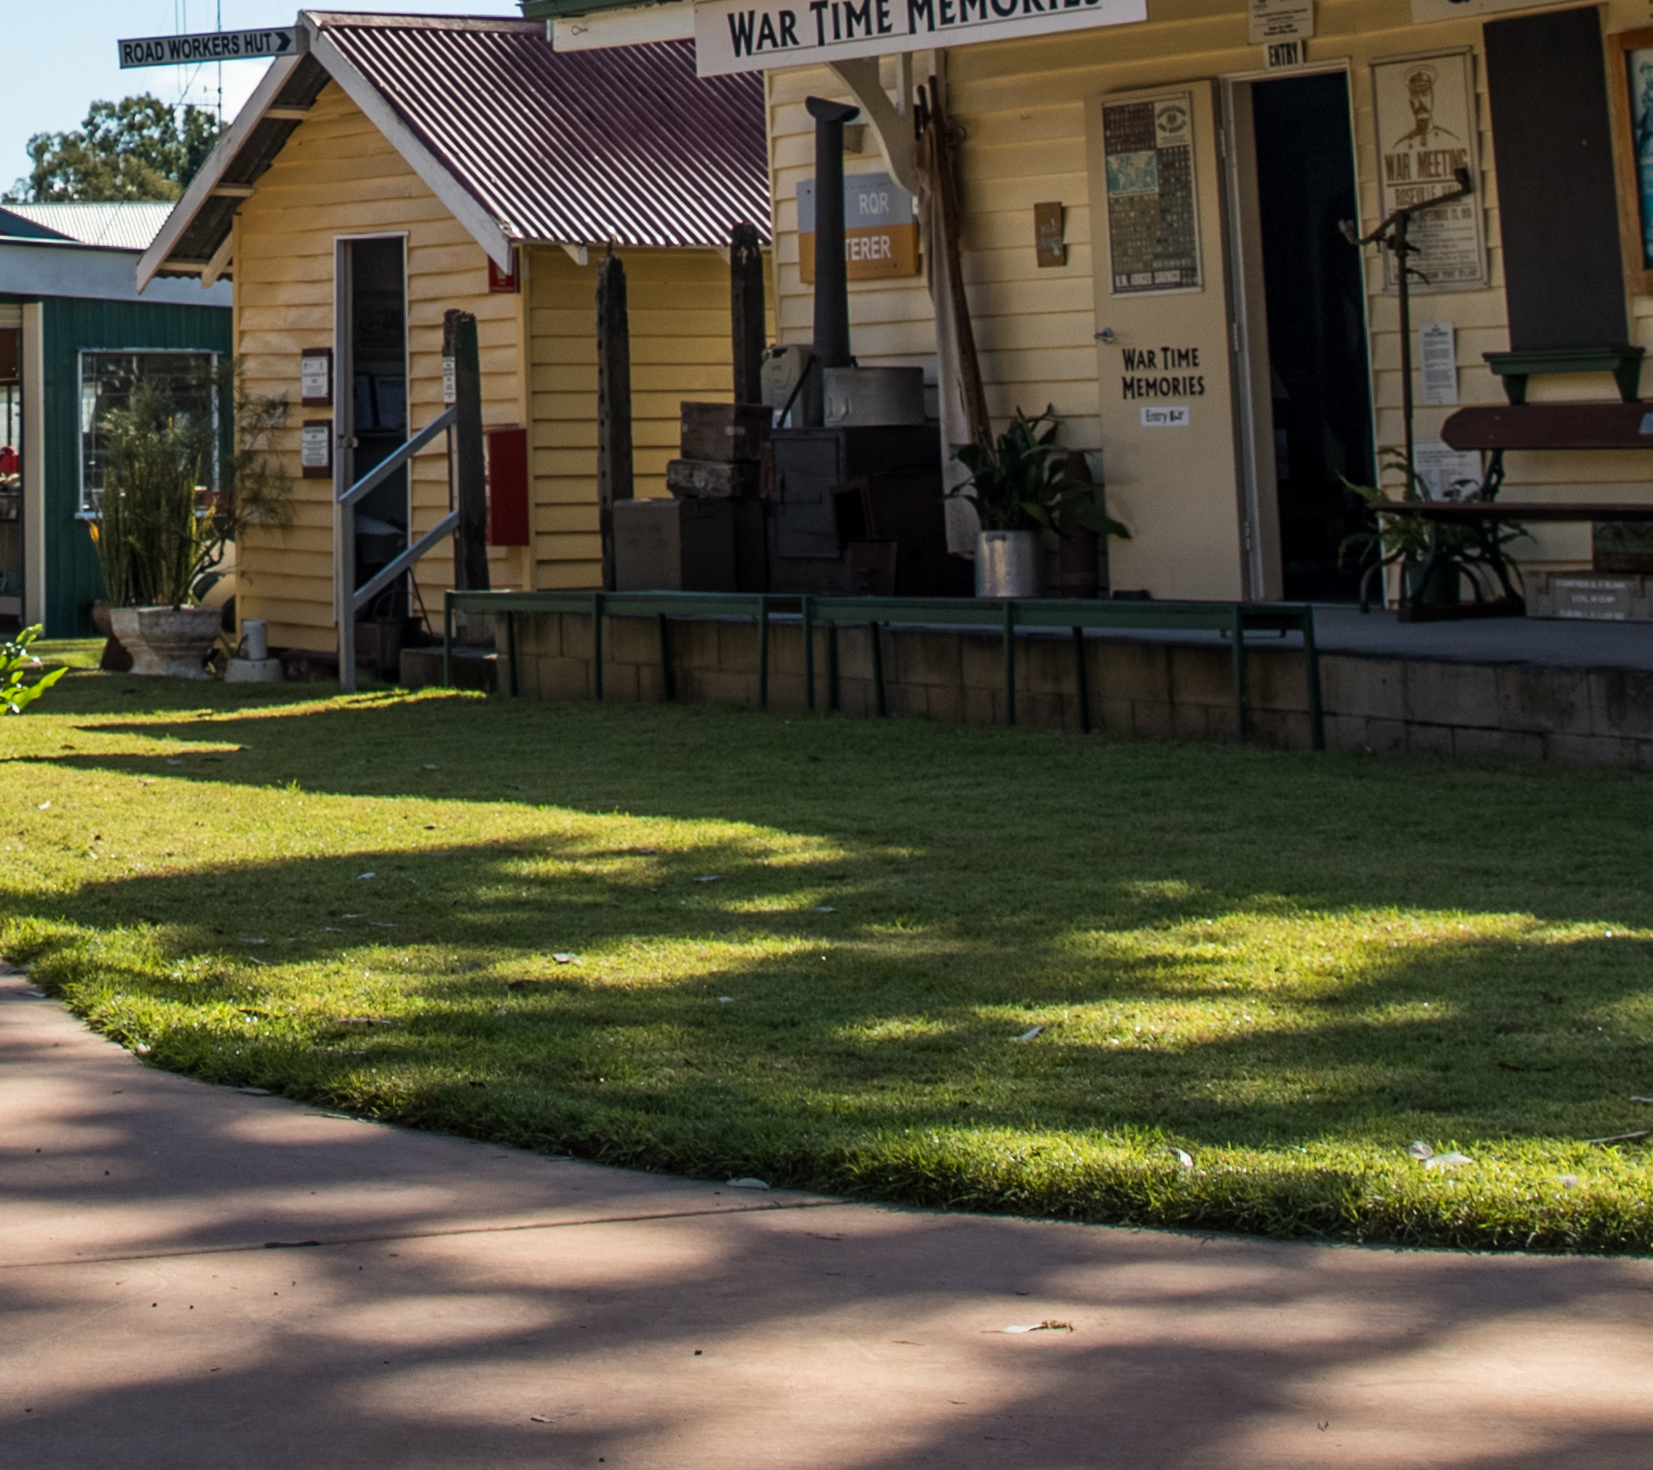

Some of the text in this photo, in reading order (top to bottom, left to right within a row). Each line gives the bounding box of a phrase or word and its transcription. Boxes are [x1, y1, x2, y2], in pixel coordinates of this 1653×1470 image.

[727, 8, 800, 58] WAR
[123, 32, 272, 64] ROAD WORKERS HUT
[1268, 41, 1298, 67] ENTRY
[1384, 152, 1411, 181] WAR
[845, 235, 891, 261] TERER
[1122, 346, 1199, 372] WAR TIME
[1121, 376, 1205, 400] MEMORIES
